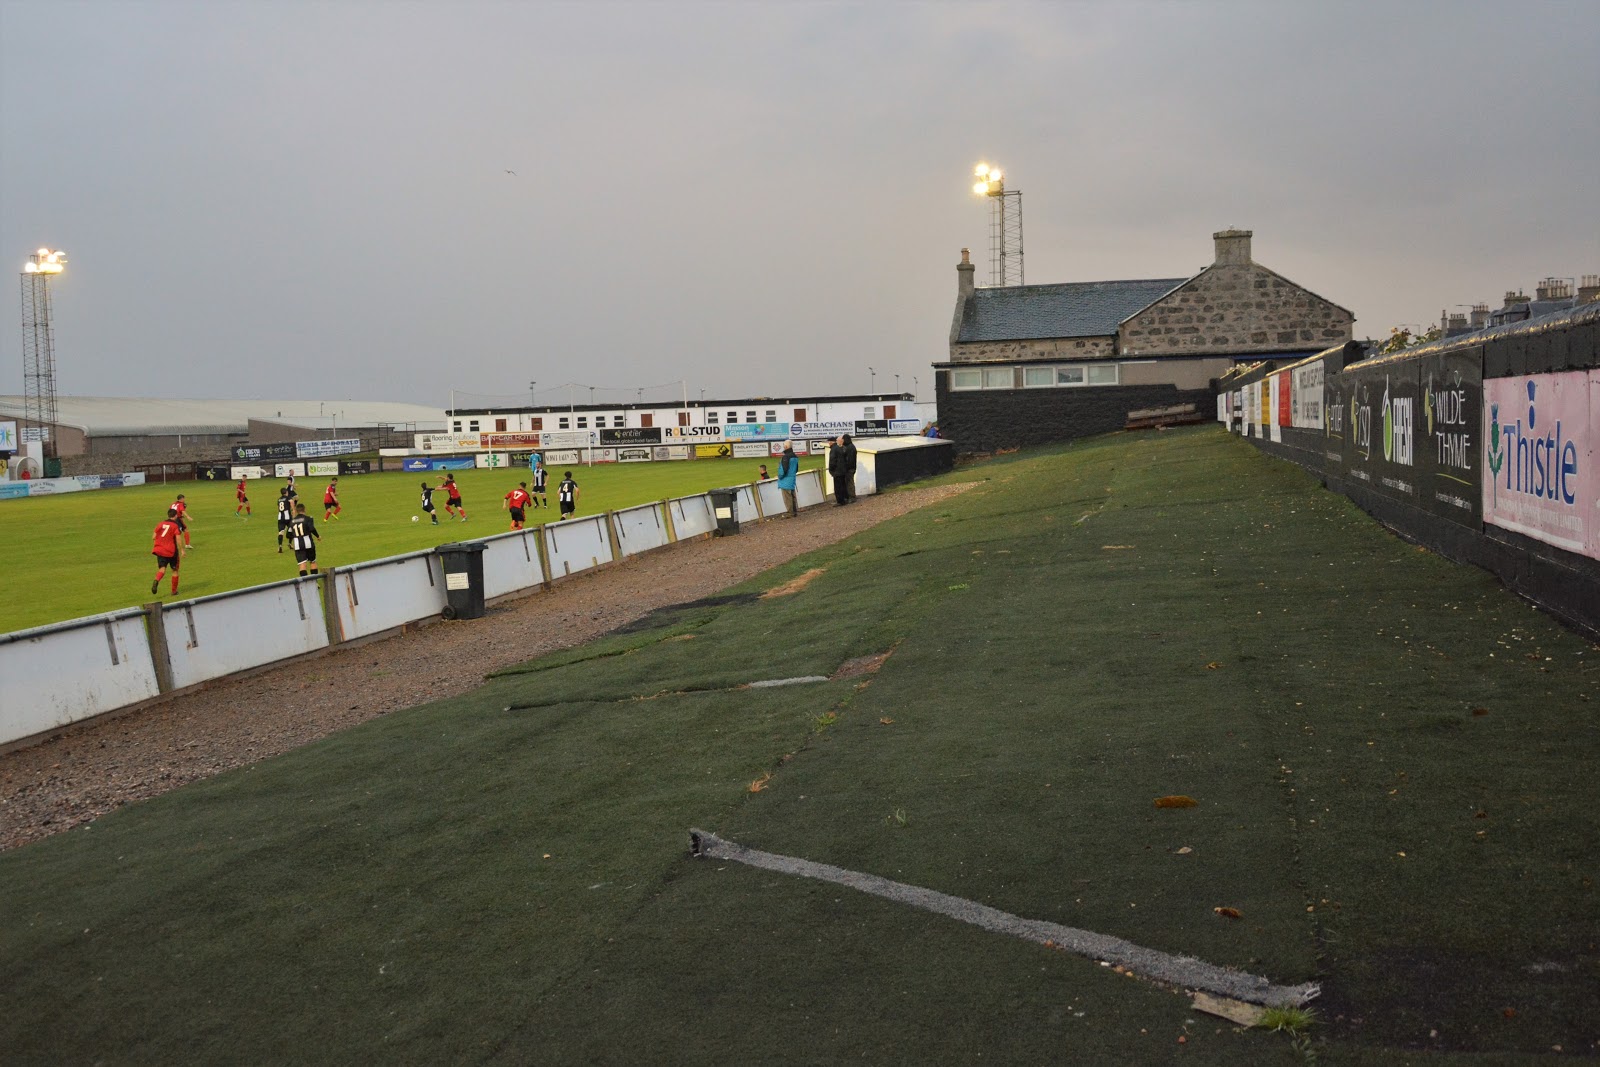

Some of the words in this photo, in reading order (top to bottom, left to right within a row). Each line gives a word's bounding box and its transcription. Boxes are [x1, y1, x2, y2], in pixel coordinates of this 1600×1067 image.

[1435, 390, 1467, 425] WILDE
[804, 421, 853, 429] STRACHANS
[622, 429, 642, 437] entier
[665, 426, 721, 437] ROLLSTUD
[1393, 397, 1413, 466] FRESH
[432, 435, 453, 443] flooring
[1435, 431, 1471, 470] THYME
[1502, 400, 1577, 505] Thistle
[317, 464, 338, 473] brakes
[562, 483, 569, 493] 4
[279, 501, 285, 512] 8
[161, 524, 171, 538] 7
[293, 523, 304, 537] 11
